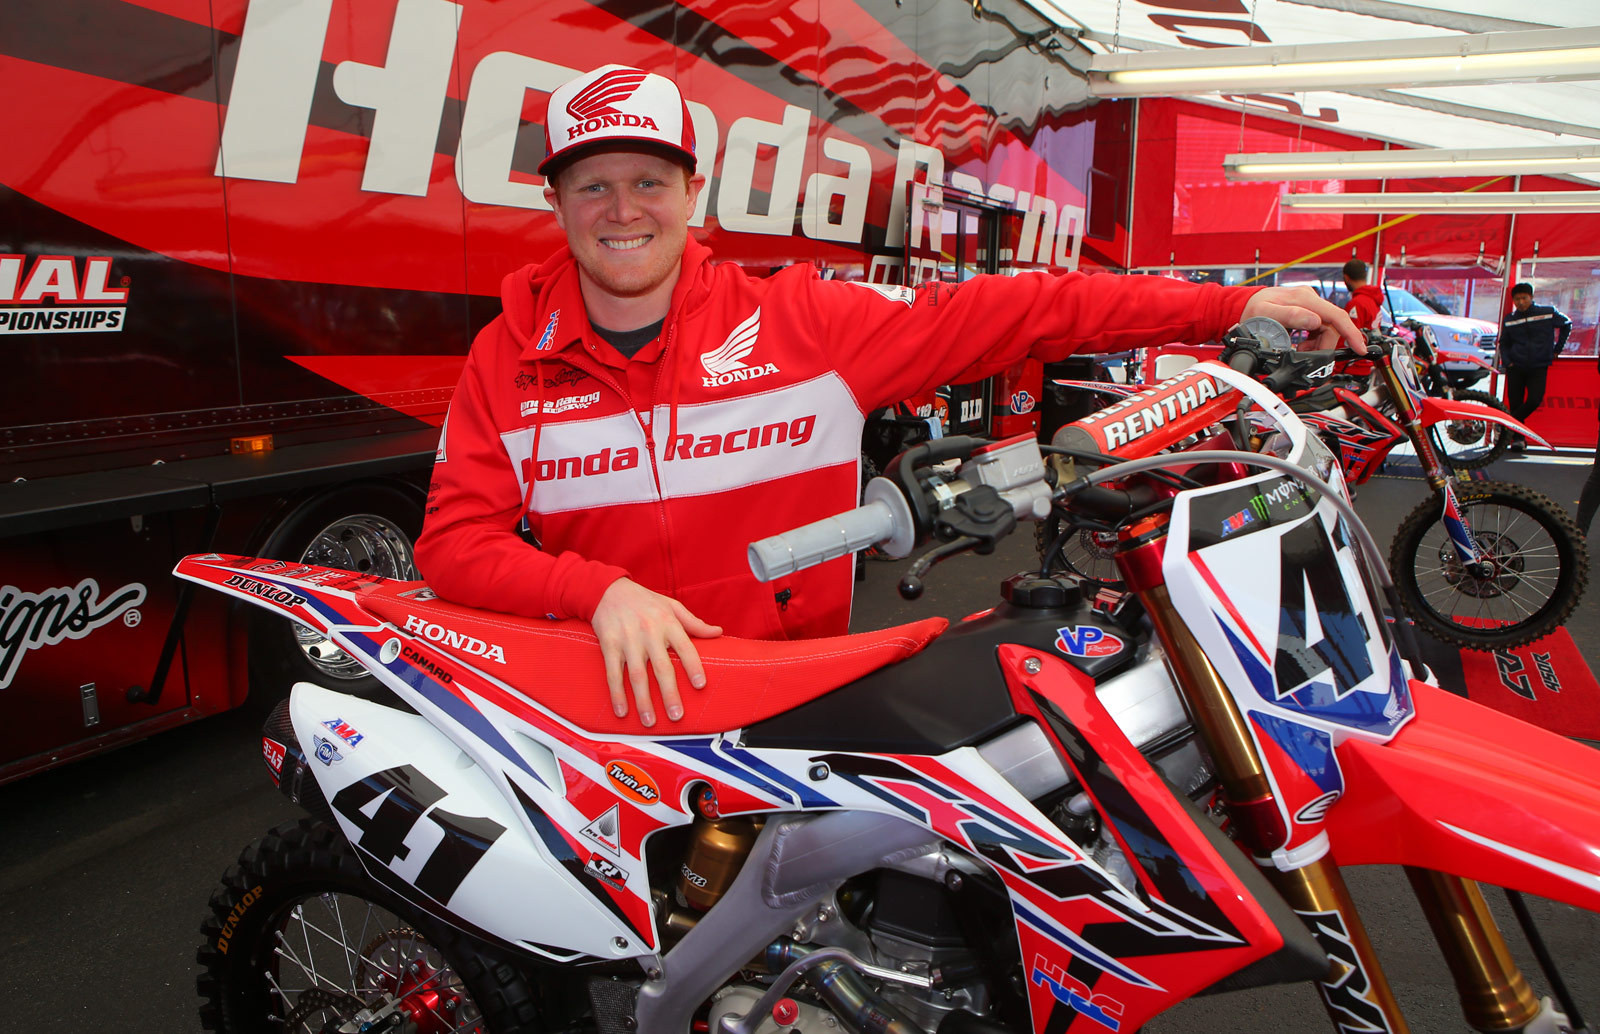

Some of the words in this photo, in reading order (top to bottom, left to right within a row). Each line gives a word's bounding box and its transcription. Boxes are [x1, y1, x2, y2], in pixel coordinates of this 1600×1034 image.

[214, 0, 872, 243] Hoda
[566, 114, 660, 141] HONDA
[701, 363, 781, 387] HONDA
[555, 391, 601, 409] Racing
[663, 414, 818, 462] Racing
[1220, 507, 1254, 538] AMA
[224, 574, 307, 608] DUNLOP
[403, 615, 507, 665] HONDA
[1056, 625, 1104, 657] VP
[402, 646, 453, 684] CANARD
[321, 718, 364, 750] AMA
[609, 764, 640, 791] Twin
[635, 784, 657, 802] Air
[331, 764, 507, 907] 41
[585, 828, 598, 838] Pro
[217, 885, 263, 955] DUNLOP
[1031, 952, 1125, 1033] HRC
